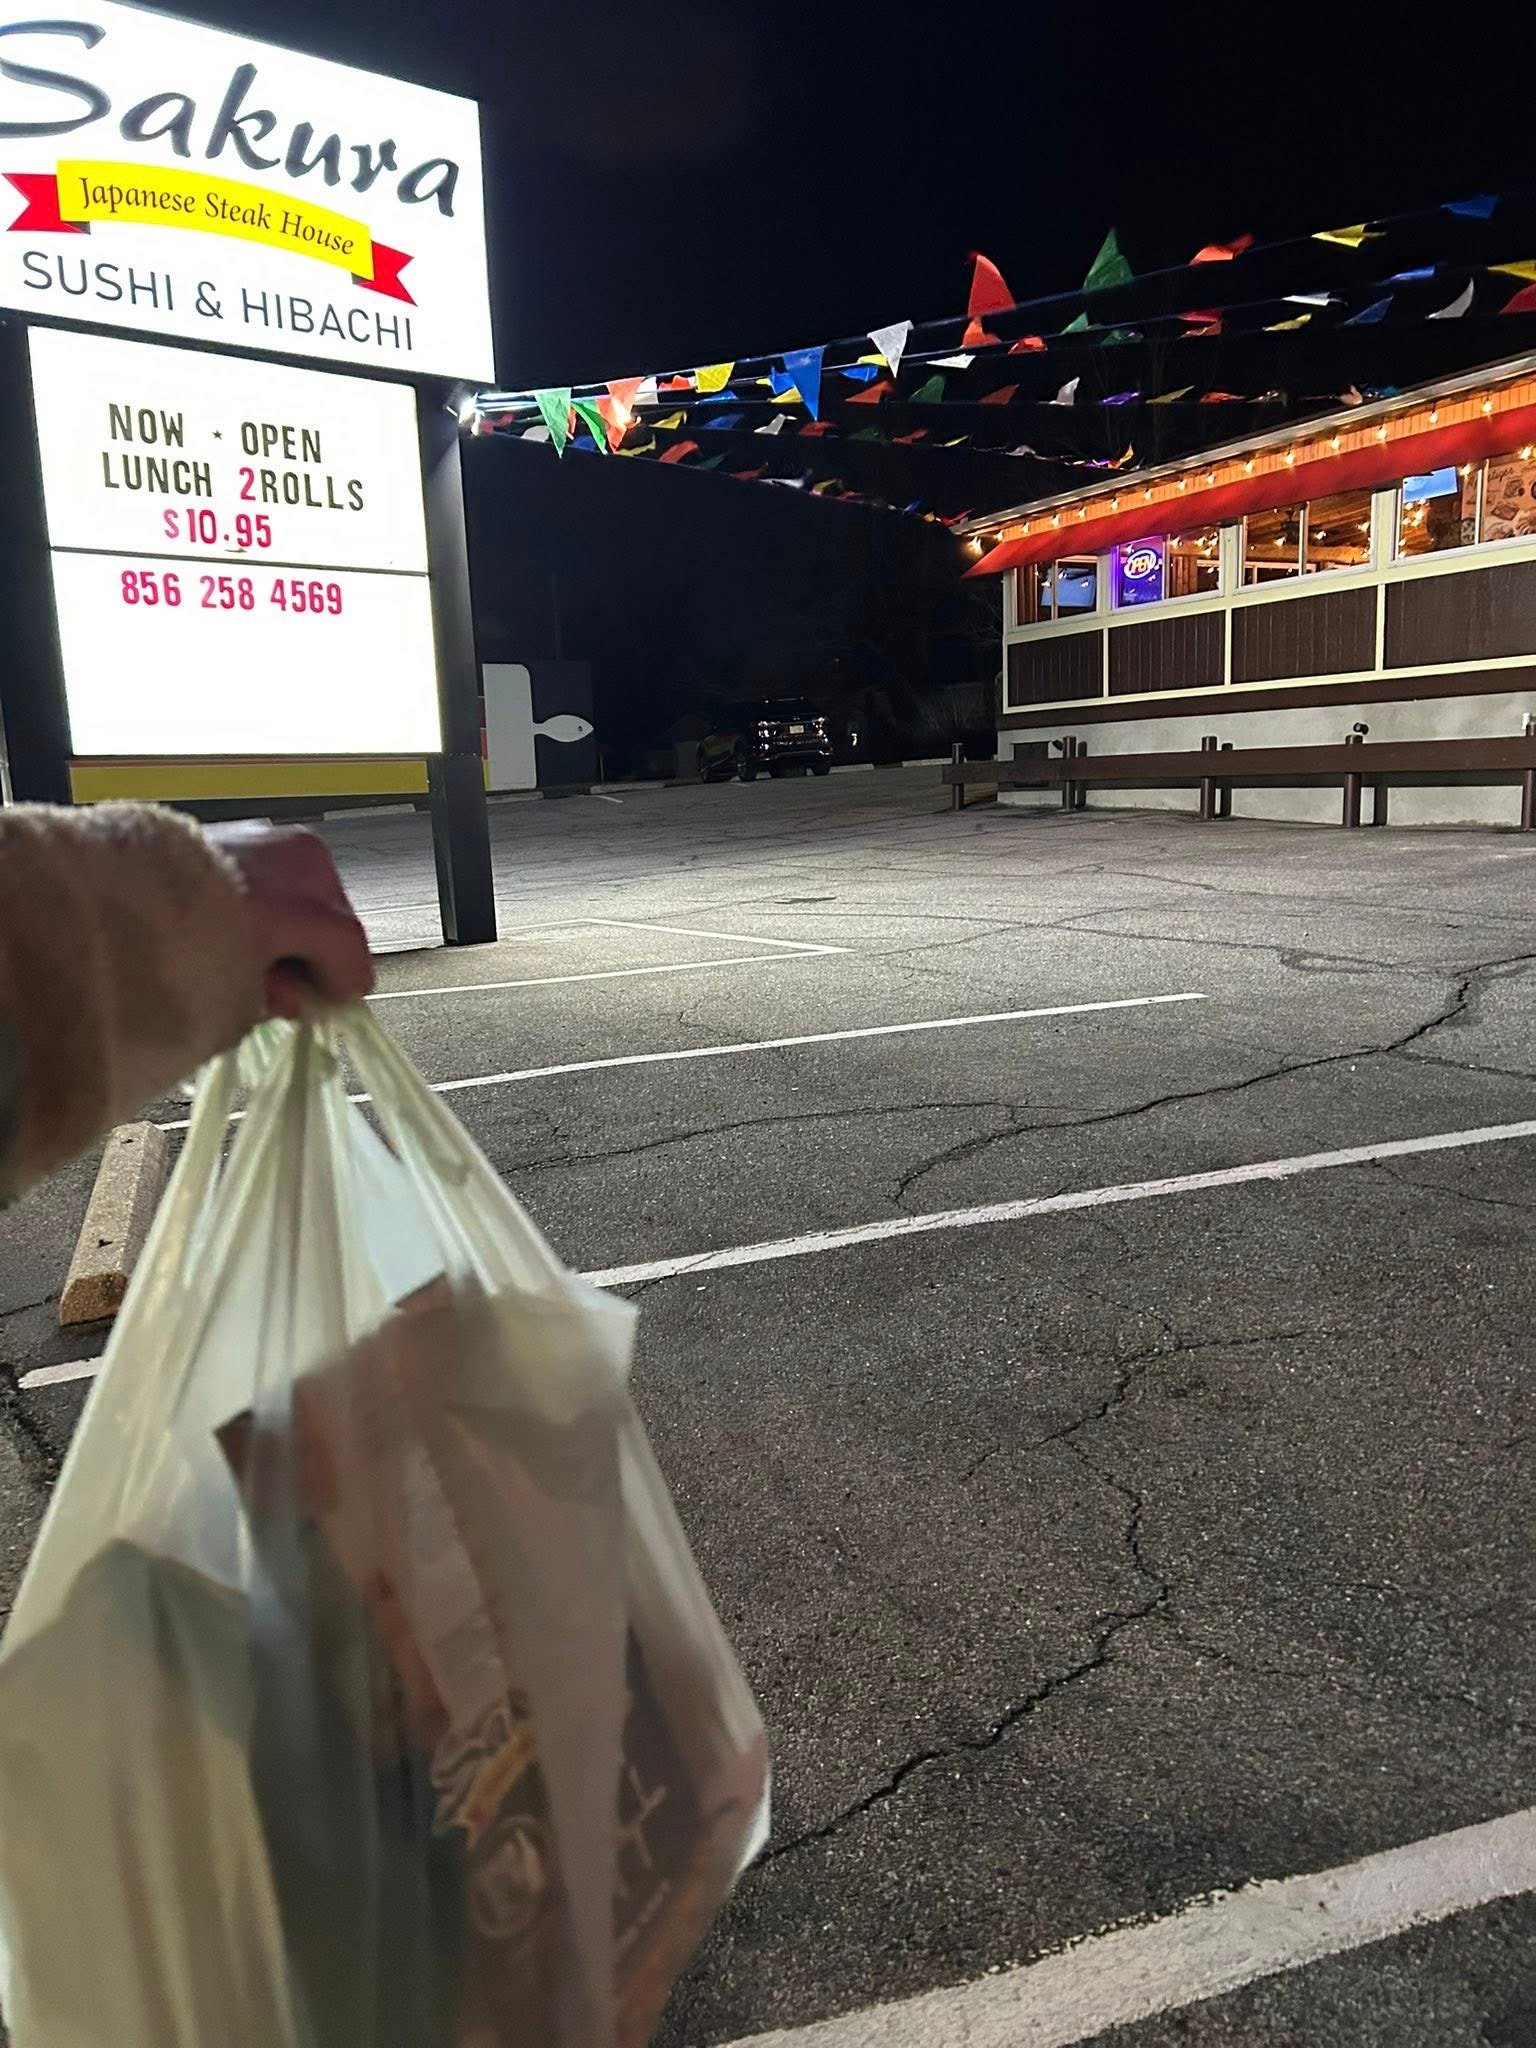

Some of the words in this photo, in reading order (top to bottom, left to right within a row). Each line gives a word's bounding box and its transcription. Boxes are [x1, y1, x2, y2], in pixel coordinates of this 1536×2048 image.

[0, 20, 459, 217] Sakura
[80, 177, 196, 214] Japanese
[205, 192, 270, 230] Steak
[281, 211, 354, 255] House
[23, 251, 173, 311] SUSHI
[195, 281, 223, 319] &
[242, 288, 412, 351] HIBACHI
[109, 403, 184, 447] NOW
[240, 421, 322, 464] OPEN
[102, 452, 213, 497] LUNCH
[163, 508, 272, 548] $10.95
[1126, 552, 1155, 575] OPEN
[121, 570, 182, 607] 856
[200, 575, 255, 611] 258
[270, 578, 343, 615] 4569
